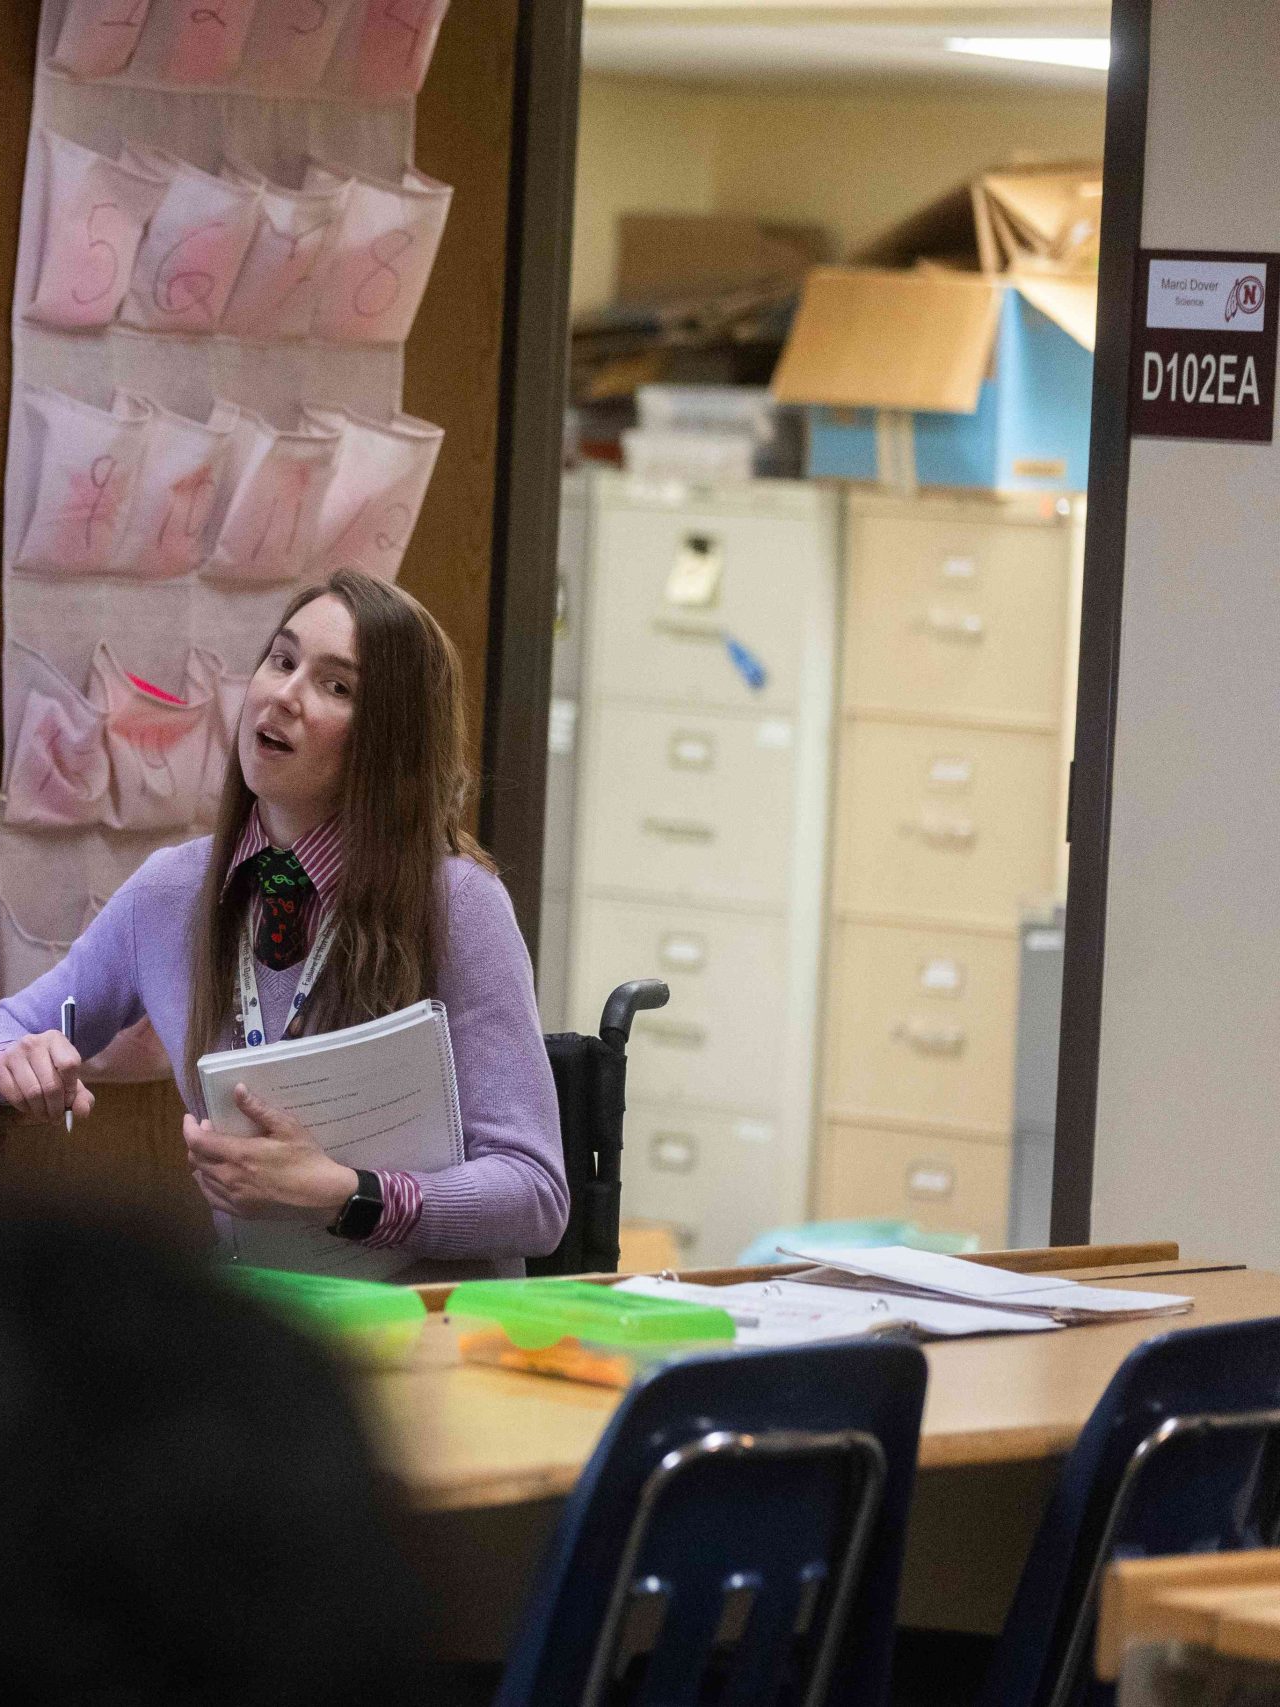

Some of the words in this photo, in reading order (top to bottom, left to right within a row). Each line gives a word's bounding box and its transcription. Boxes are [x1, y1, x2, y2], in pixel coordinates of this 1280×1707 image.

[72, 202, 119, 305] 5
[353, 228, 413, 318] 8
[1161, 278, 1188, 291] Marci
[1190, 278, 1219, 292] Dover
[1175, 296, 1205, 307] Science
[1142, 351, 1260, 406] D102EA
[86, 455, 117, 550] 9
[244, 967, 252, 991] Option
